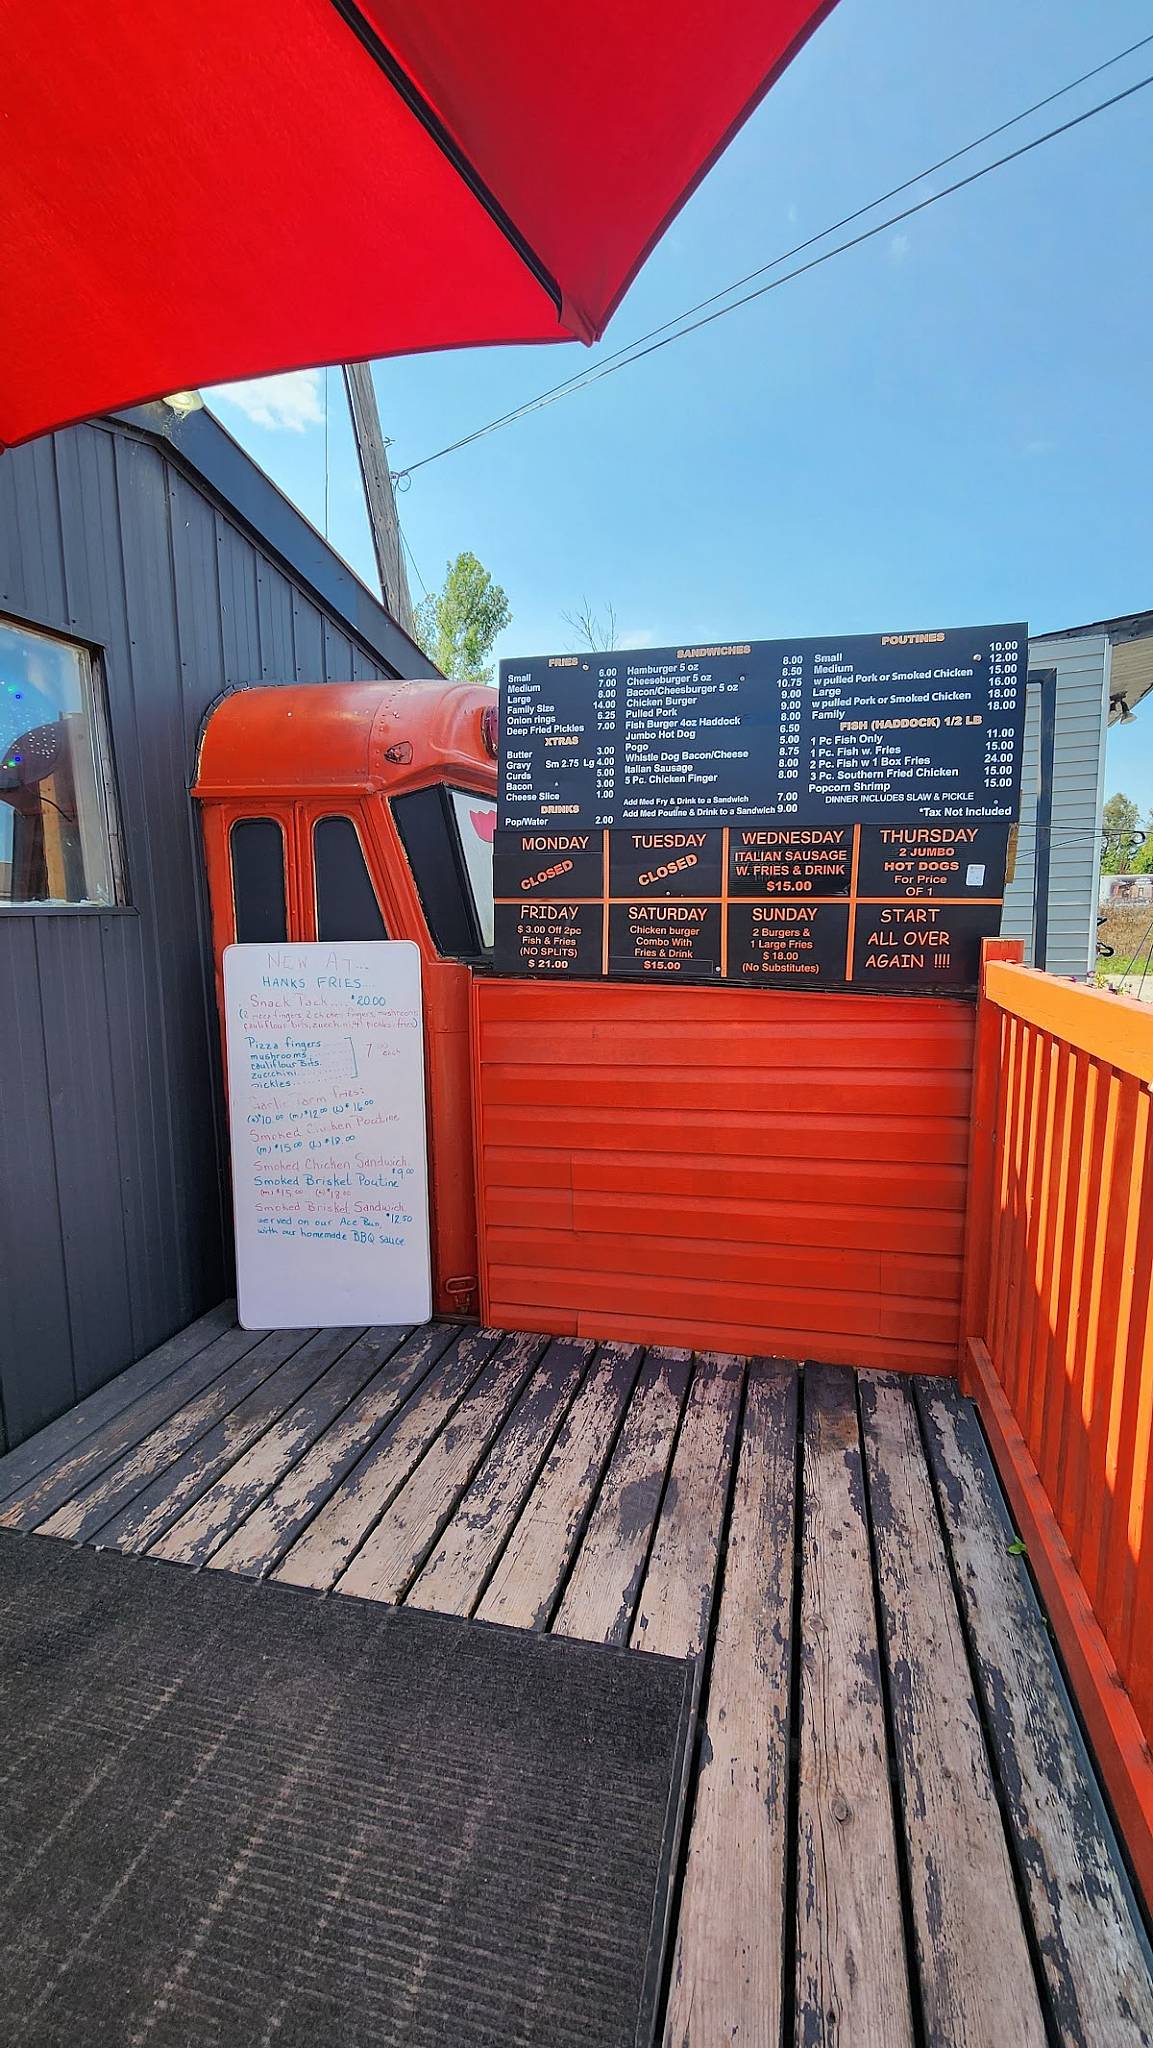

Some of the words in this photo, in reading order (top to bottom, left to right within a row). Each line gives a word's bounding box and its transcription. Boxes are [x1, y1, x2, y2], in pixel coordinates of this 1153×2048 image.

[881, 633, 945, 646] POUTINES
[676, 645, 752, 659] SANDWICHES
[814, 653, 842, 663] Small
[989, 640, 1018, 651] 10.00
[548, 658, 578, 667] FRIES
[627, 665, 678, 675] Hamburger
[783, 656, 803, 665] 8.00
[814, 663, 853, 674] Medium
[989, 653, 1018, 663] 12.00
[508, 674, 531, 682] Small
[599, 668, 617, 677] 6.00
[508, 684, 541, 693] Medium
[598, 679, 616, 688] 7.00
[812, 687, 842, 698] Large
[988, 676, 1017, 686] 16.00
[627, 698, 662, 708] Chicken
[665, 697, 698, 706] Burger
[781, 690, 802, 699] 9.00
[507, 706, 535, 716] Family
[593, 701, 616, 709] 14.00
[626, 709, 653, 719] Pulled
[656, 708, 678, 717] Pork
[781, 701, 801, 710] 9.00
[811, 710, 846, 721] Family
[987, 700, 1016, 711] 18.00
[507, 716, 532, 725] Onion
[534, 715, 556, 724] rings
[598, 711, 616, 720] 6.25
[839, 720, 868, 731] FISH
[871, 718, 940, 731] (HADDOCK)
[944, 716, 963, 727] 1/2
[965, 715, 982, 726] LB
[507, 727, 528, 736] Deep
[530, 725, 551, 734] Fried
[553, 724, 584, 733] Pickles
[598, 722, 615, 731] 7.00
[625, 731, 656, 740] Jumbo
[658, 730, 675, 739] Hot
[677, 730, 696, 739] Dog
[779, 723, 800, 733] 6.50
[544, 736, 579, 747] XTRAS
[811, 736, 816, 746] 1
[819, 735, 832, 745] Pc
[835, 735, 856, 745] Fish
[859, 734, 883, 745] Only
[987, 728, 1014, 738] 11.00
[507, 751, 532, 759] Butter
[597, 747, 615, 755] 3.00
[625, 764, 651, 774] Italian
[653, 763, 693, 774] Sausage
[778, 758, 798, 767] 8.00
[809, 783, 850, 794] Popcorn
[854, 781, 890, 792] Shrimp
[984, 778, 1012, 788] 15.00
[540, 805, 580, 814] DRINKS
[944, 807, 963, 816] Not
[965, 806, 1012, 816] Included
[505, 818, 549, 827] Pop/Water
[595, 816, 613, 824] 2.00
[522, 836, 590, 850] MONDAY
[631, 833, 707, 849] TUESDAY
[742, 830, 844, 845] WEDNESDAY
[879, 828, 979, 844] THURSDAY
[735, 850, 782, 861] ITALIAN
[784, 850, 847, 861] SAUSAGE
[899, 848, 907, 857] 2
[910, 847, 955, 857] JUMBO
[638, 853, 698, 886] CLOSED
[753, 865, 790, 876] FRIES
[792, 865, 802, 875] &
[804, 864, 845, 875] DRINK
[884, 861, 915, 871] HOT
[918, 861, 960, 871] DOGS
[520, 859, 574, 890] CLOSED
[894, 875, 914, 884] For
[916, 875, 947, 884] Price
[766, 881, 812, 892] $15.00
[905, 887, 923, 896] OF
[927, 887, 933, 896] 1
[520, 904, 579, 920] FRIDAY
[628, 906, 708, 922] SATURDAY
[751, 907, 818, 921] SUNDAY
[880, 909, 941, 924] START
[548, 925, 562, 934] Off
[564, 926, 581, 936] 2pc
[629, 926, 667, 935] Chicken
[669, 927, 700, 938] burger
[752, 927, 759, 937] 2
[762, 927, 800, 938] Burgers
[802, 928, 810, 937] &
[522, 936, 541, 945] Fish
[544, 937, 550, 945] &
[553, 937, 576, 946] Fries
[636, 937, 669, 946] Combo
[671, 938, 693, 947] With
[750, 940, 755, 949] 1
[758, 940, 787, 950] Large
[789, 940, 813, 950] Fries
[868, 931, 898, 946] ALL
[903, 931, 950, 946] OVER
[519, 947, 538, 956] (NO
[540, 947, 578, 958] SPLITS)
[634, 948, 657, 957] Fries
[659, 949, 666, 958] &
[668, 949, 694, 958] Drink
[644, 961, 681, 970] $15.00
[865, 953, 924, 969] AGAIN
[742, 963, 759, 973] (No
[761, 963, 820, 974] Substitutes)
[262, 975, 305, 989] HANKS
[244, 1036, 278, 1050] Pizza
[286, 1037, 321, 1051] fingers
[254, 1160, 299, 1171] Smoked
[305, 1158, 351, 1170] Chicken
[254, 1175, 299, 1186] Smoked
[357, 1174, 400, 1187] Poutine
[255, 1202, 300, 1212] Smoked
[340, 1217, 357, 1226] Ace
[301, 1227, 347, 1240] homemade
[351, 1228, 375, 1243] BBQ
